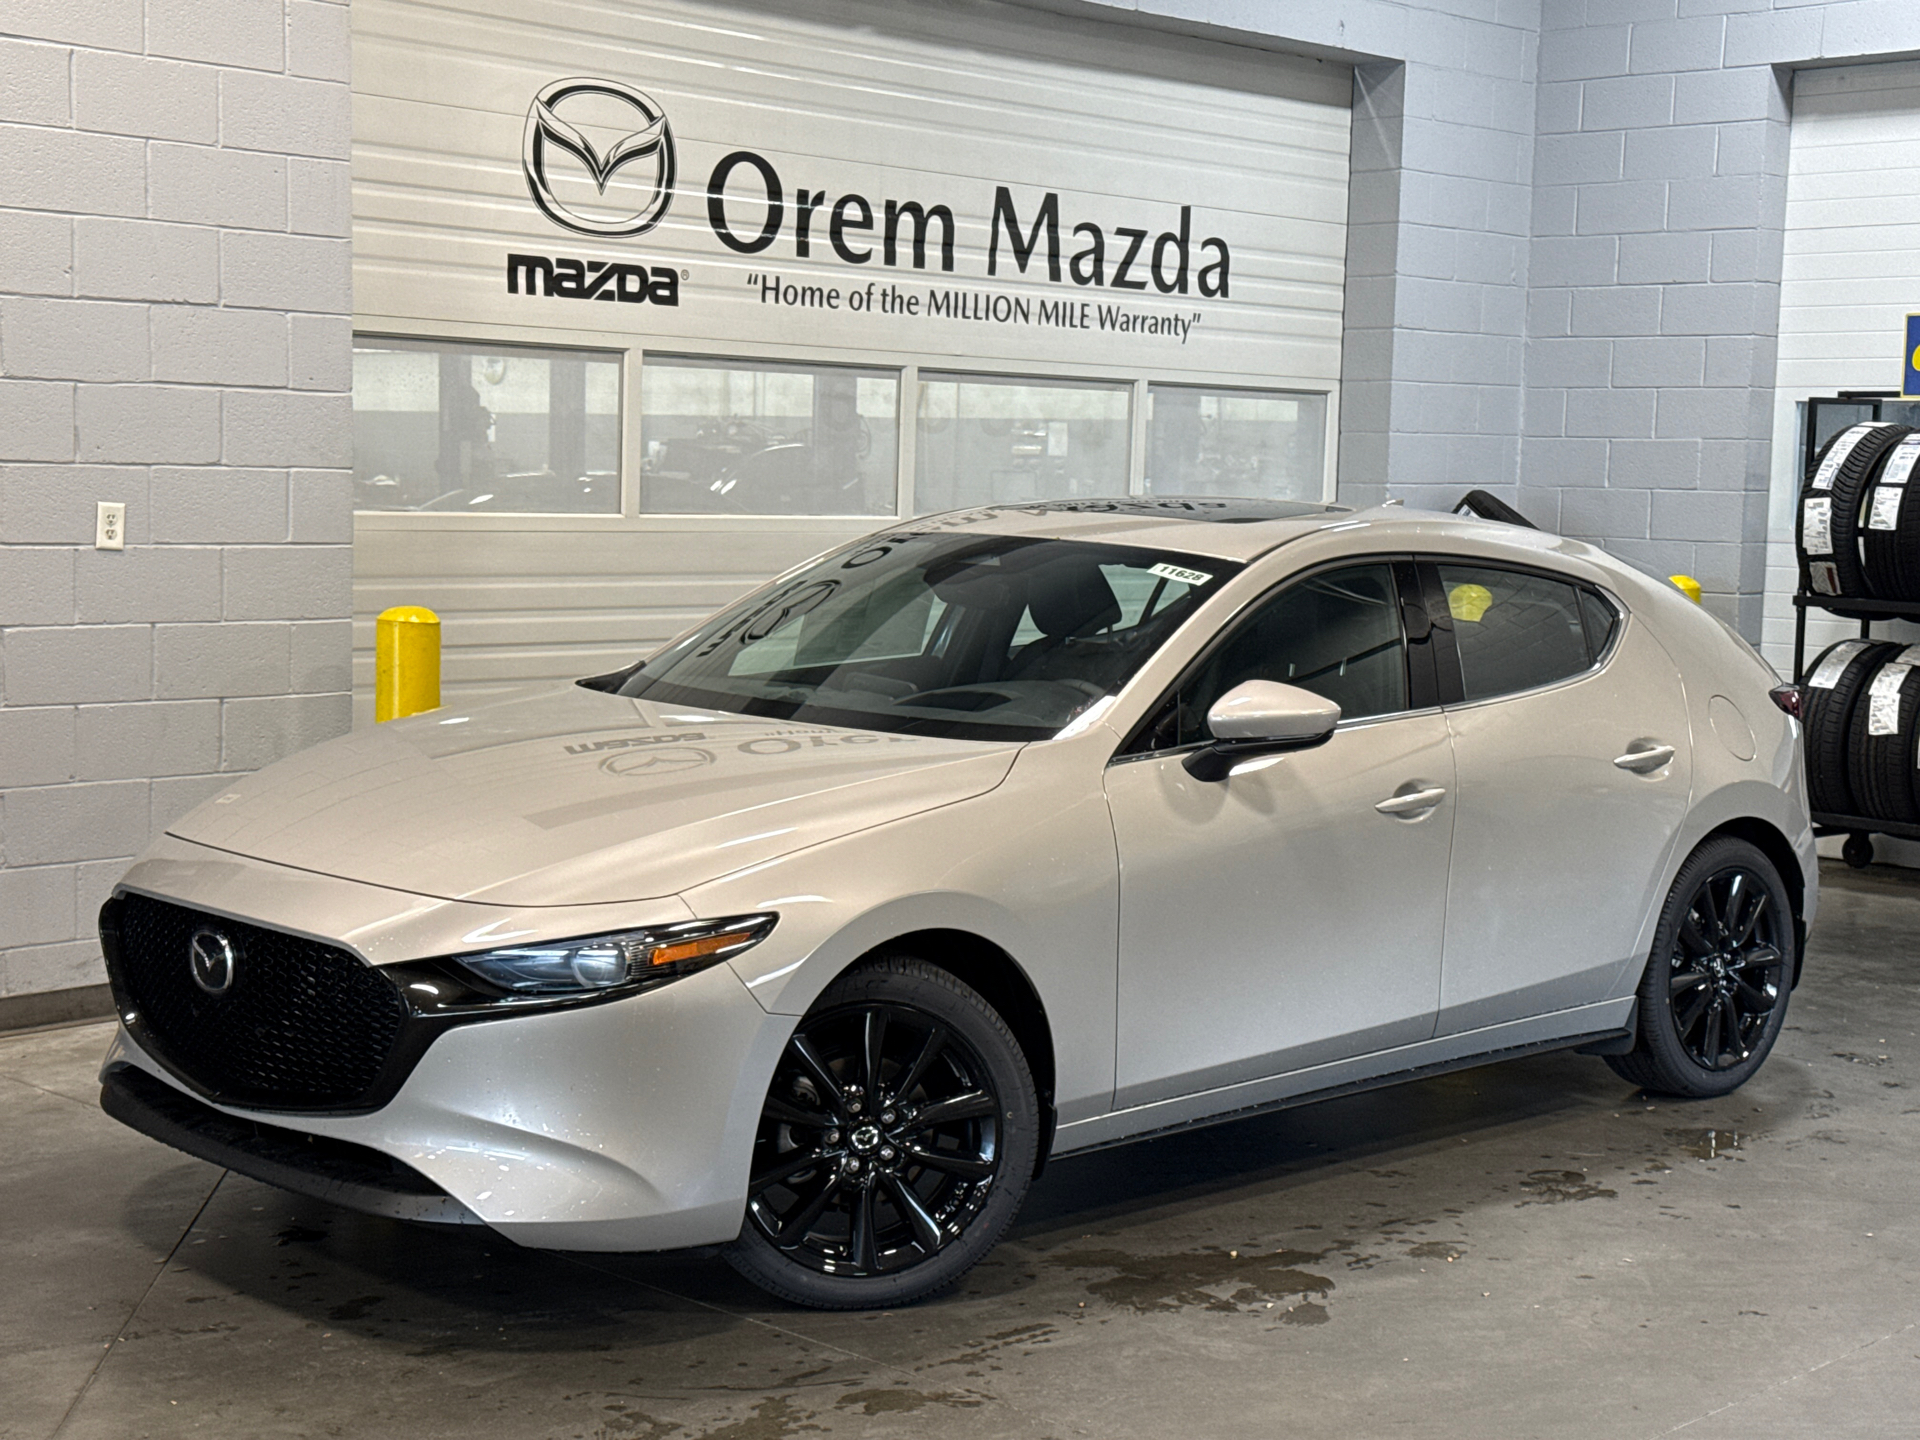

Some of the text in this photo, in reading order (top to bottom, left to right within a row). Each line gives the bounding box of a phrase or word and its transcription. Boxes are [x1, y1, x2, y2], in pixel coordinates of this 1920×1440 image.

[707, 151, 1231, 298] Orem Mazda
[747, 273, 1201, 344] “Home of the MILLION MILE Warranty”
[1159, 566, 1205, 581] 11628
